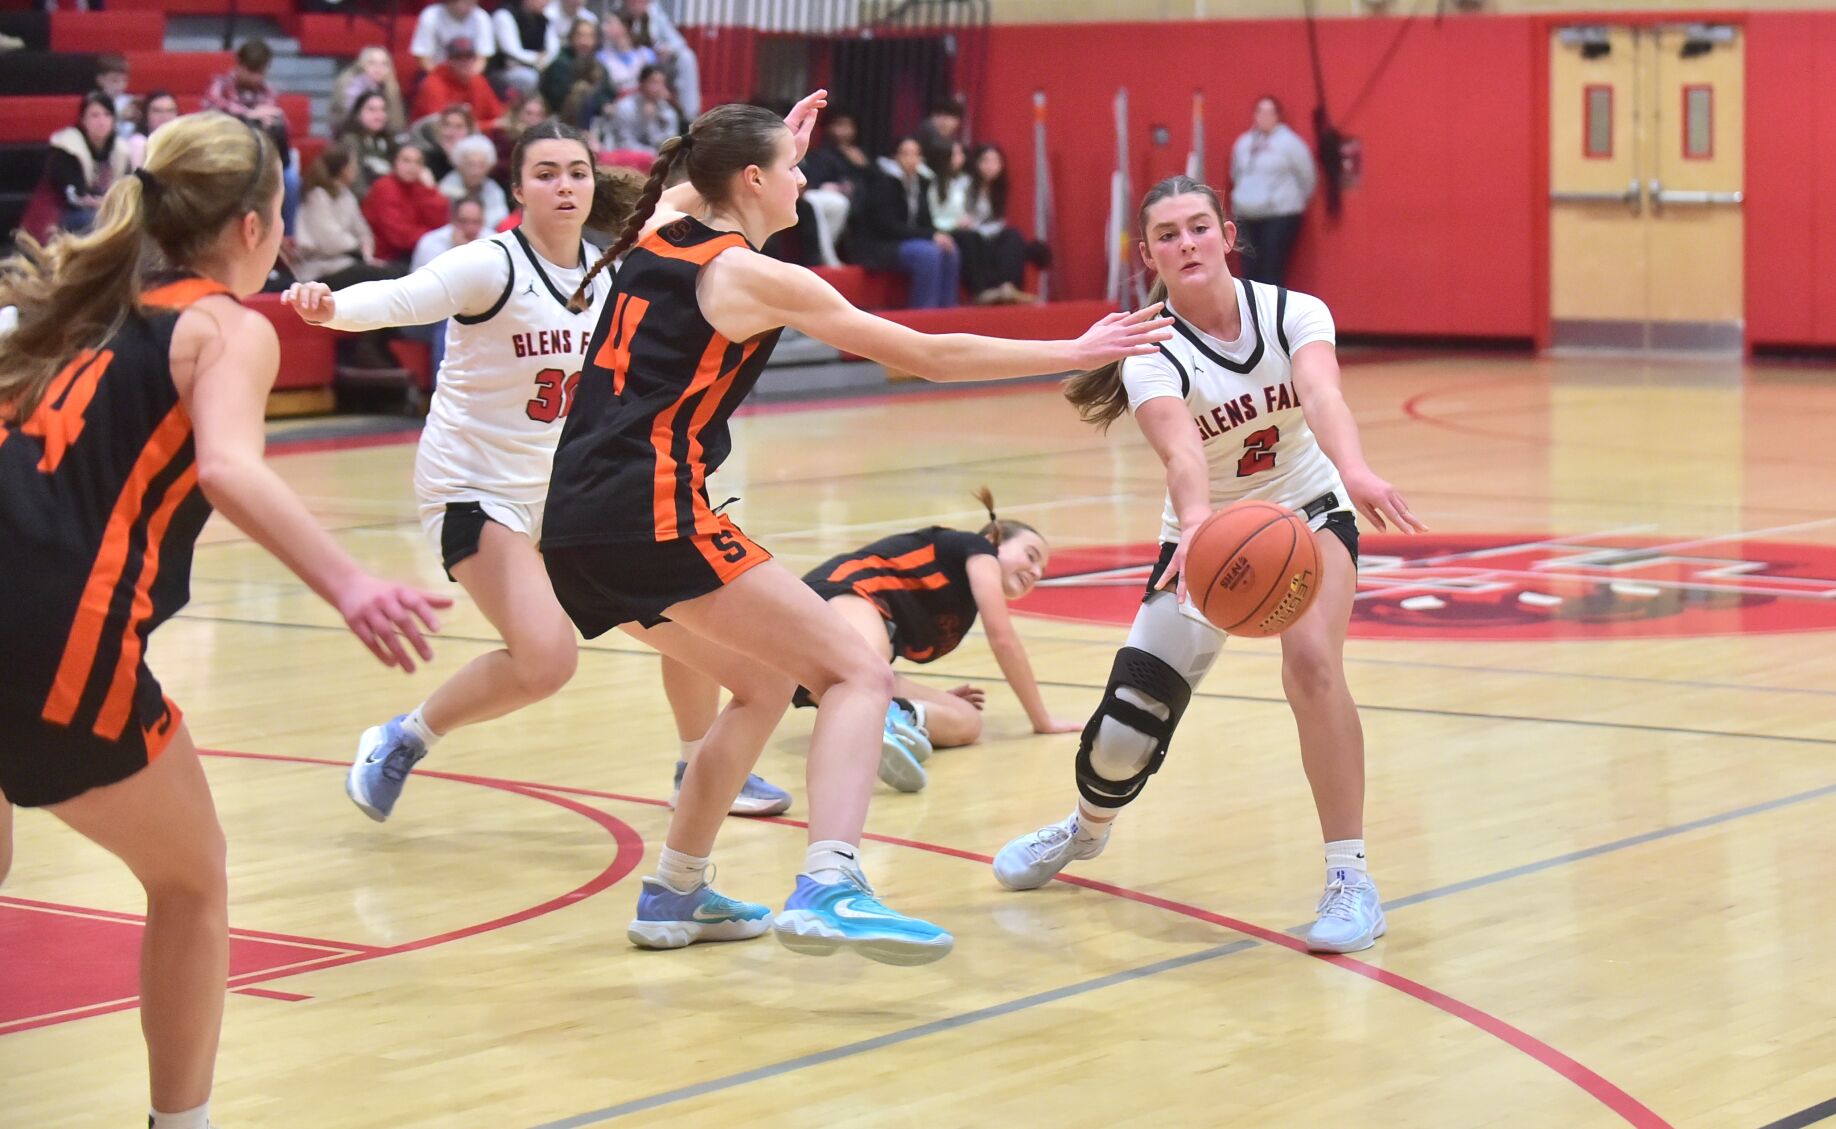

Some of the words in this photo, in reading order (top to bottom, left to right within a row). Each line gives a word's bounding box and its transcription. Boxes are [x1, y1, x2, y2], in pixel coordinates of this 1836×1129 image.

[512, 330, 572, 358] GLENS
[593, 292, 650, 396] 4
[0, 347, 115, 474] 4
[1236, 424, 1280, 478] 2
[711, 530, 747, 563] S
